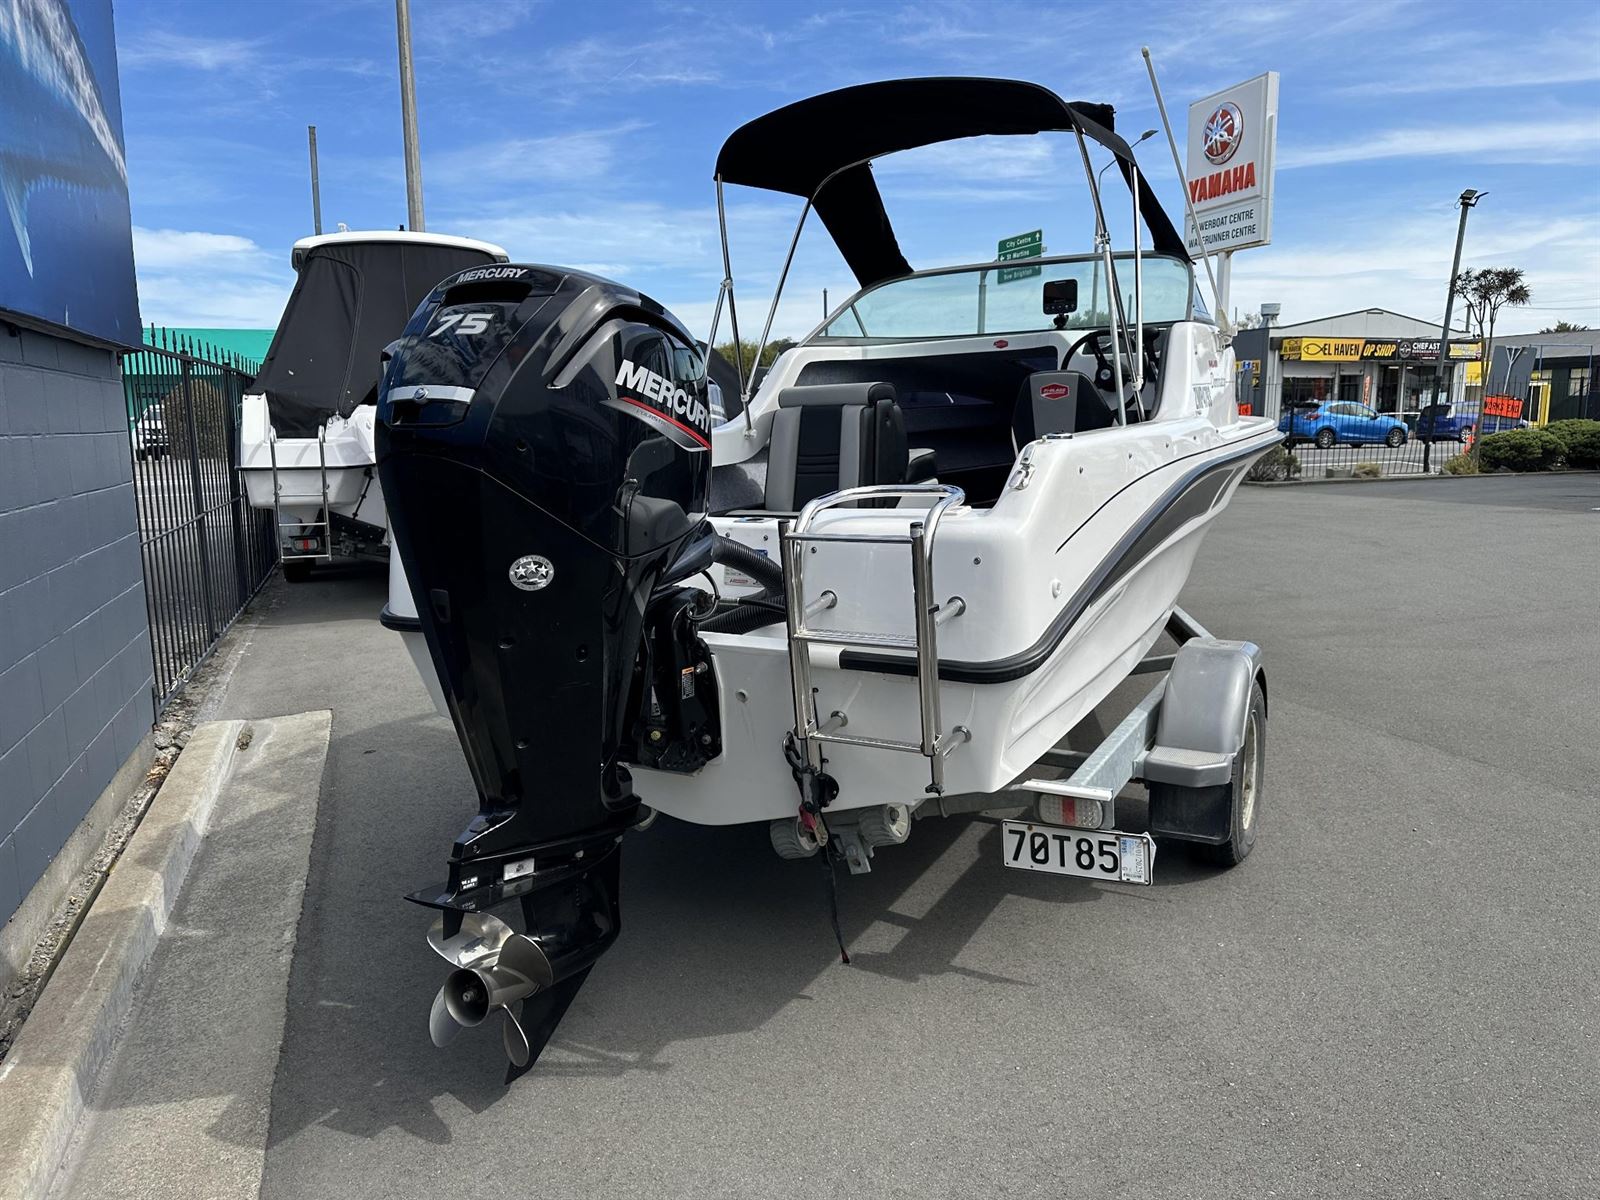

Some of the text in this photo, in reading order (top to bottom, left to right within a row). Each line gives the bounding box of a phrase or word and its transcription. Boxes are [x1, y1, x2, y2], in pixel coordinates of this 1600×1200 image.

[1188, 161, 1256, 204] YAMAHA
[1191, 208, 1254, 234] PWERBOAT CENTRE
[1005, 237, 1031, 249] City Centre
[1188, 223, 1257, 248] WAERUNNER CENTRE
[456, 268, 528, 284] MERCURY
[427, 313, 495, 338] 75
[1323, 343, 1397, 357] EL HAVEN OP SHOP
[1412, 342, 1441, 350] CHEFAST
[615, 359, 710, 433] MERCURY
[1008, 829, 1119, 874] 70T85
